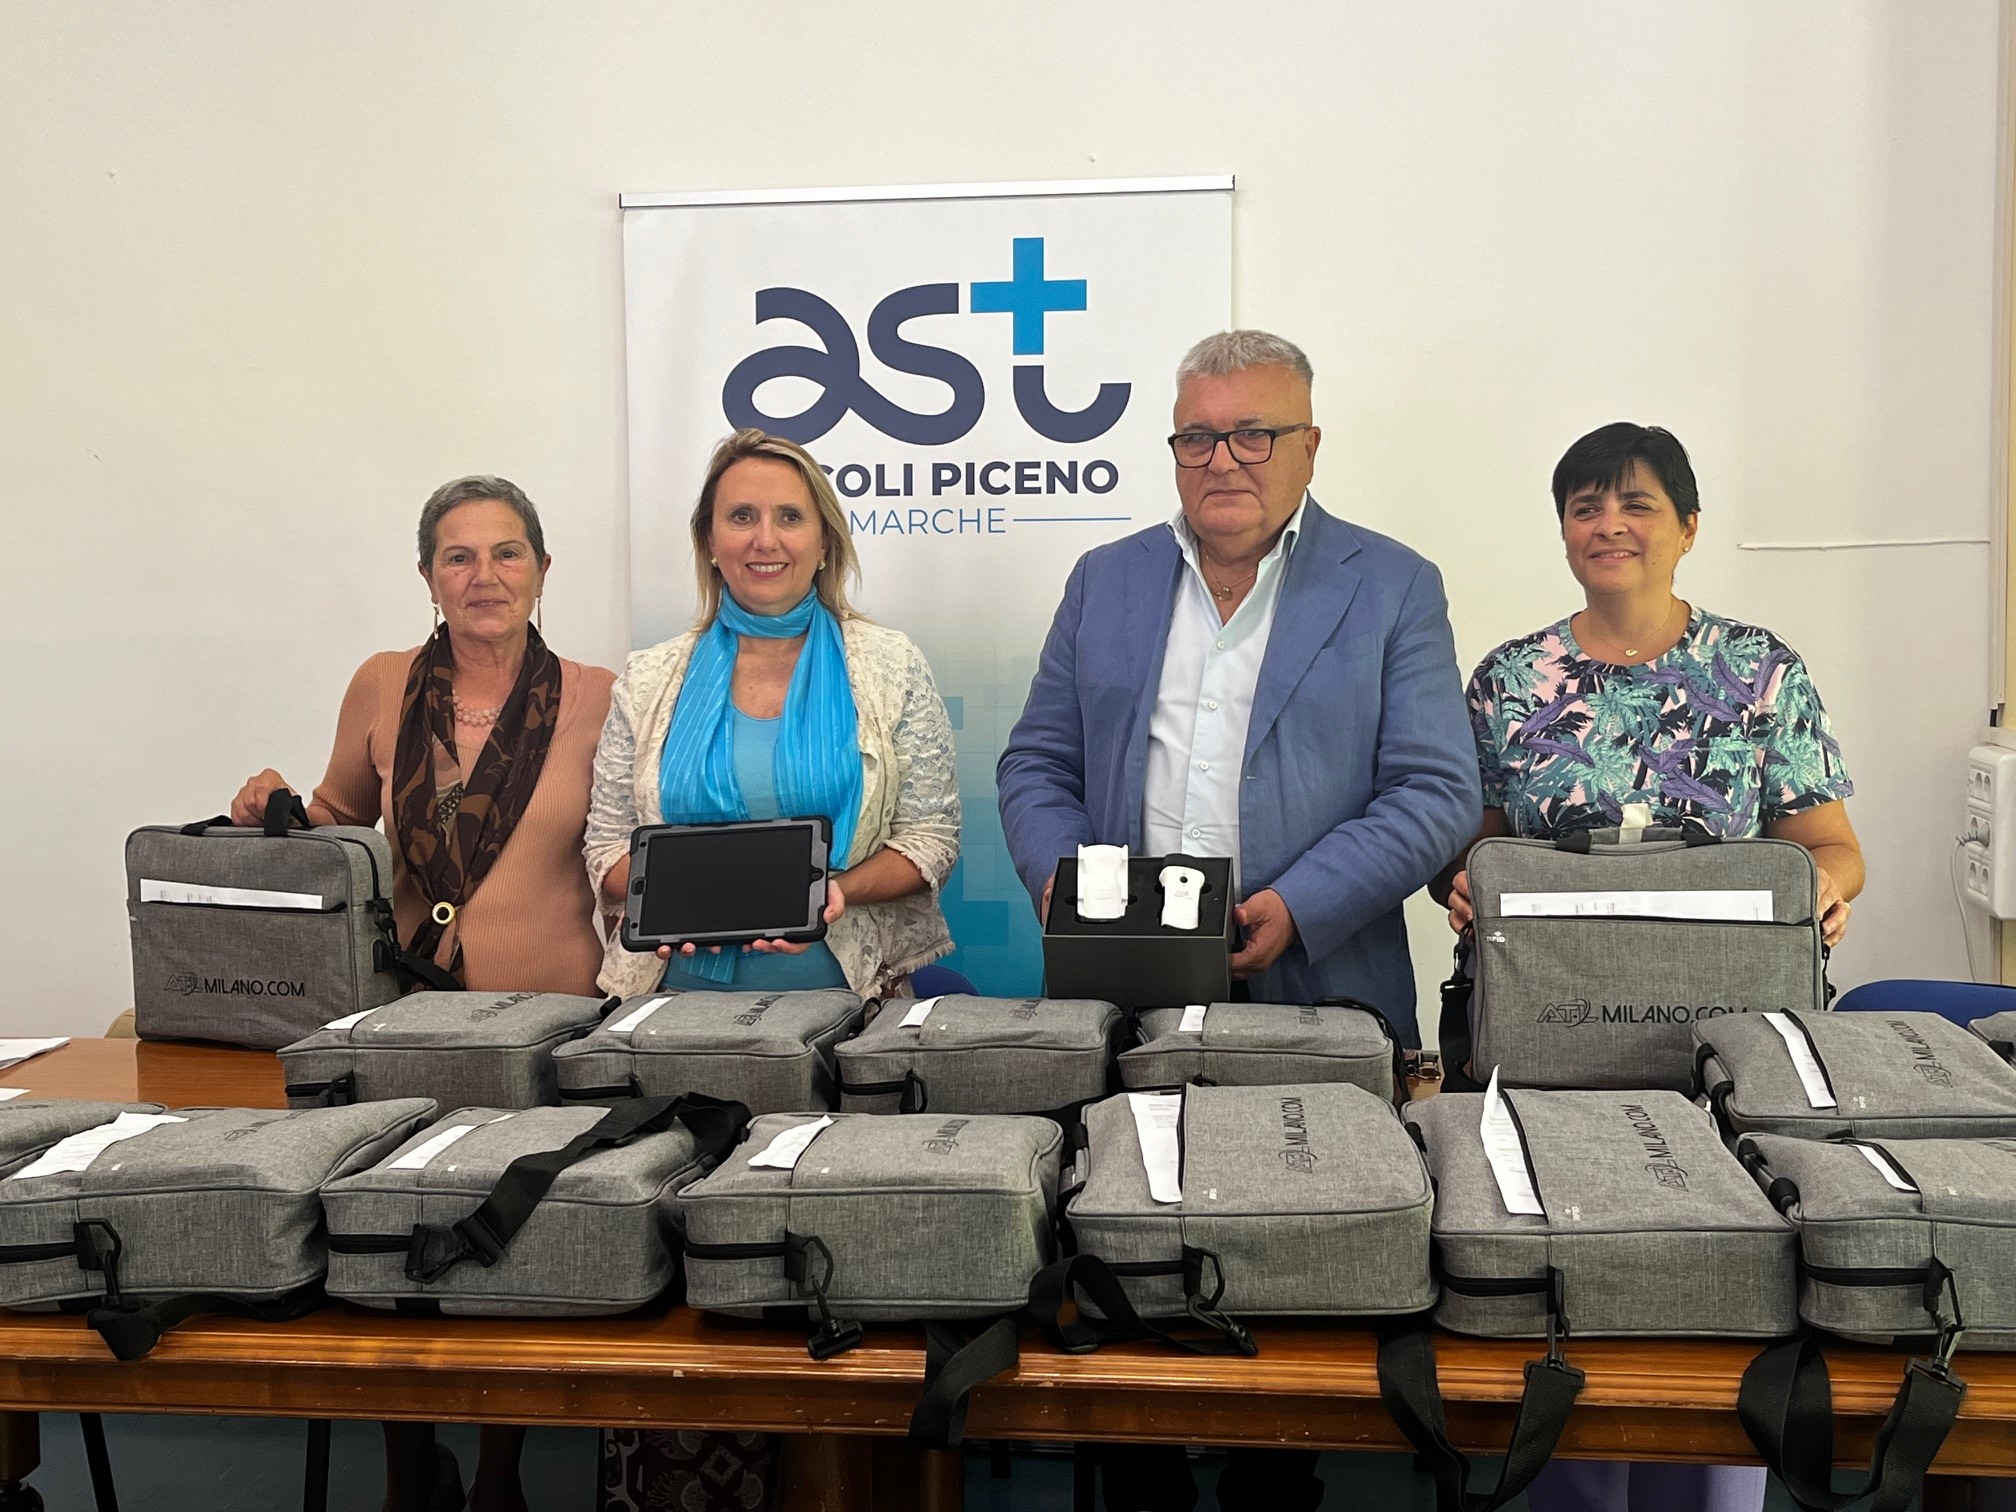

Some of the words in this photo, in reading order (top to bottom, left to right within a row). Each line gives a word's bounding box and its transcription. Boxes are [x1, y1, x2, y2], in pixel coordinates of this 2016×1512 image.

[722, 237, 1132, 446] ast
[819, 461, 914, 499] OLI
[931, 460, 1120, 496] PICENO
[850, 508, 1007, 536] MARCHE
[204, 978, 306, 998] MILANO.COM
